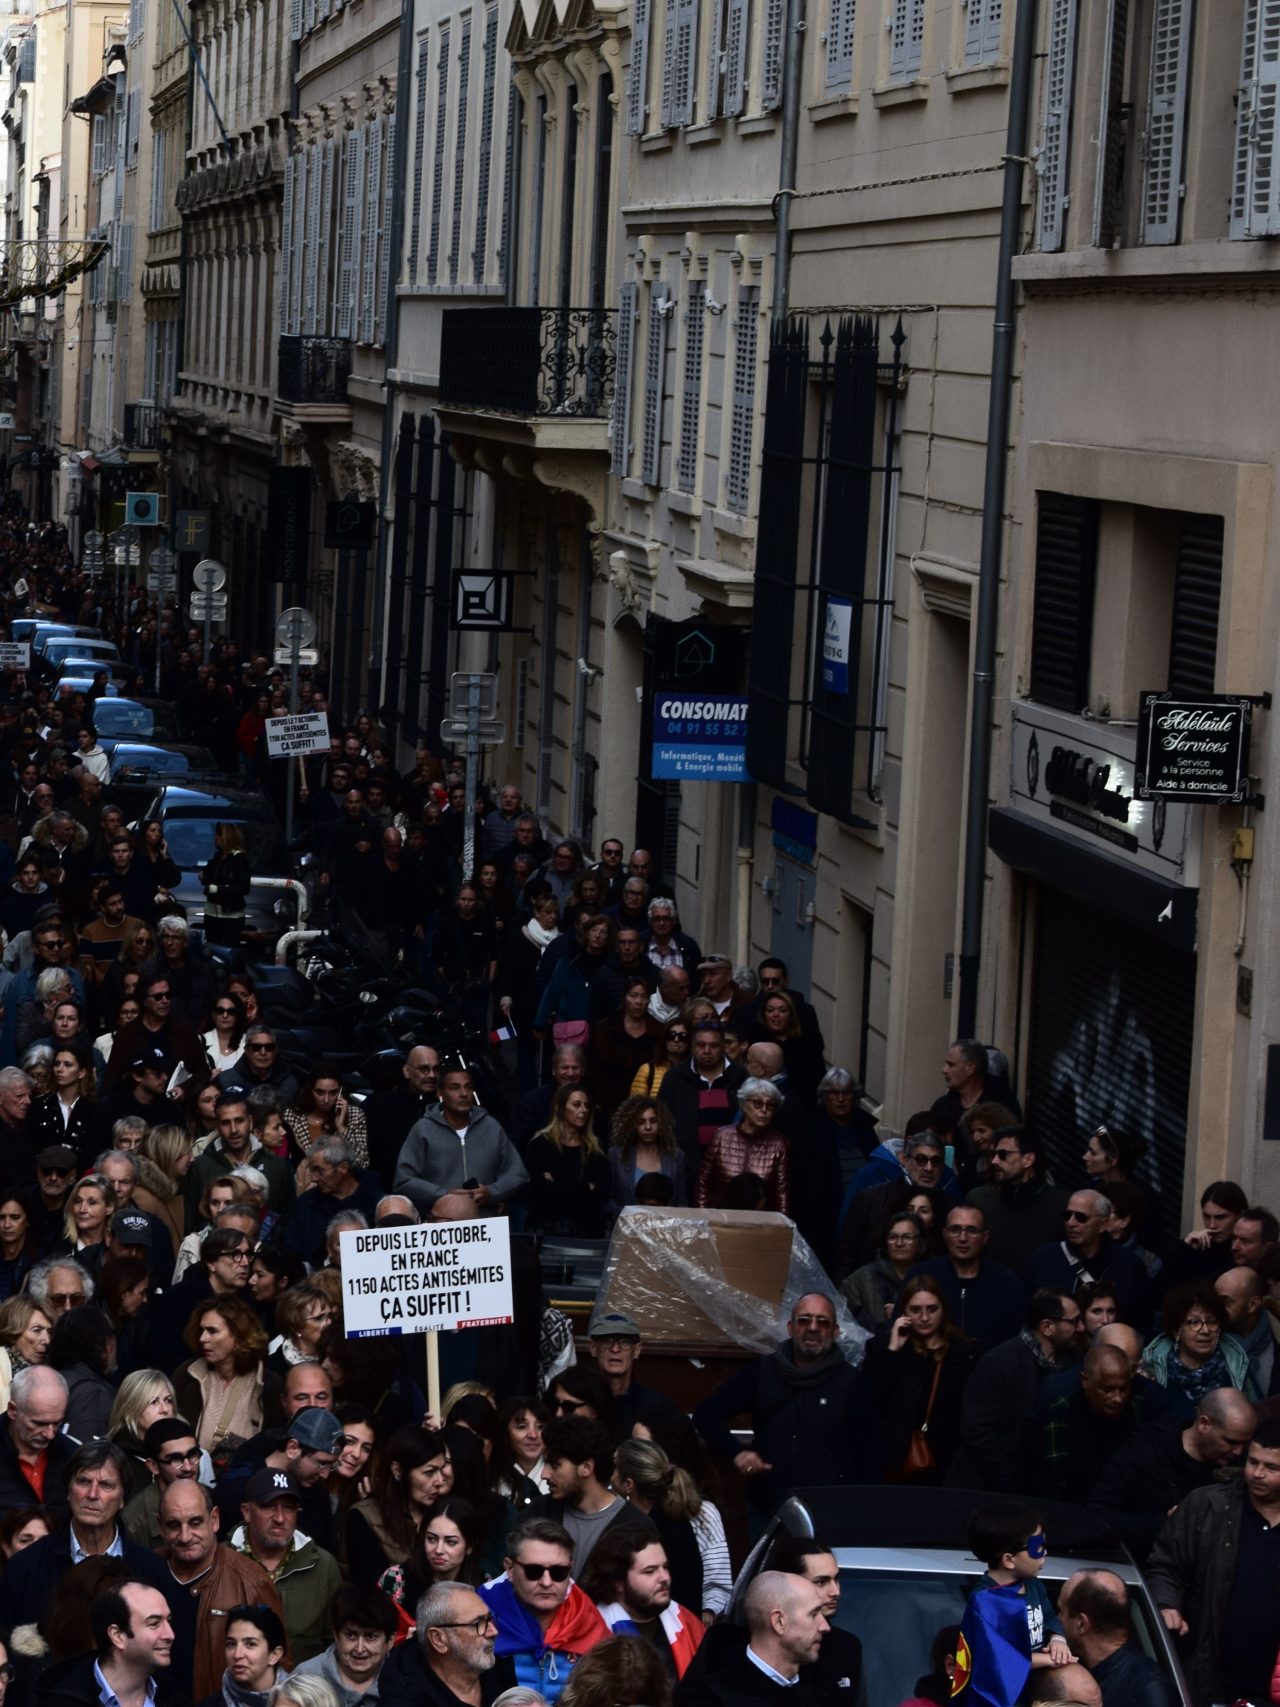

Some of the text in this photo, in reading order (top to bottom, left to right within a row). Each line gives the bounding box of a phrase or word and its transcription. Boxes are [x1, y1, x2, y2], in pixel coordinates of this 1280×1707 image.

[667, 721, 682, 734] 04
[687, 722, 700, 735] 91
[705, 723, 720, 736] 55
[723, 723, 738, 736] 52
[1157, 709, 1237, 732] Adélaïde
[291, 739, 311, 750] SUFFIT
[1160, 731, 1230, 754] Services
[661, 750, 715, 762] Informatique,
[1177, 757, 1211, 768] Service
[675, 761, 682, 770] &
[716, 763, 743, 772] mobile
[1162, 765, 1224, 777] à la personne
[1156, 779, 1229, 791] Aide à domicile
[356, 1225, 491, 1253] DEPUIS LE 7 OCTOBRE,
[391, 1249, 459, 1271] EN FRANCE
[348, 1265, 504, 1295] 1150 ACTES ANTISÉMITES
[381, 1290, 471, 1323] ÇA SUFFIT !
[358, 1316, 507, 1338] LIBERTÉ ÉGALITÉ FRATERNITÉ
